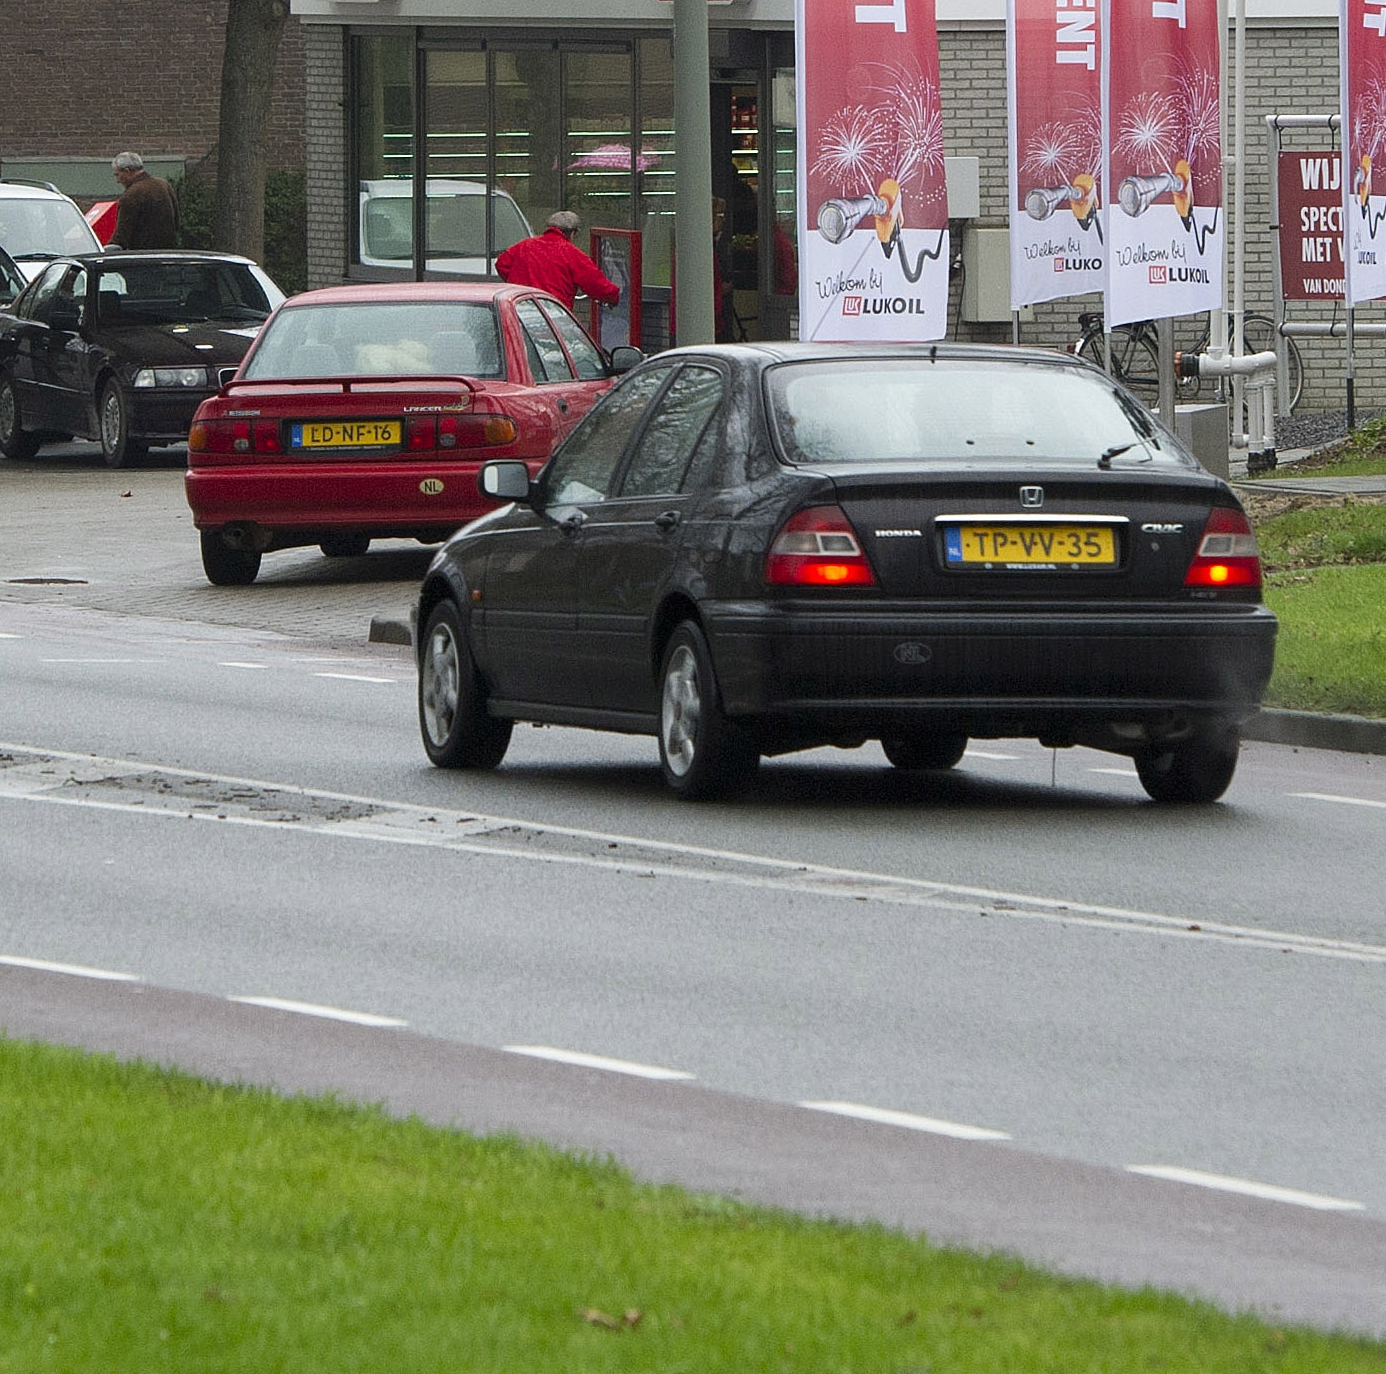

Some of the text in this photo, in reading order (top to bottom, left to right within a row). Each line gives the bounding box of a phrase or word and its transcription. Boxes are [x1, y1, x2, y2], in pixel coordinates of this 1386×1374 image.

[1300, 158, 1342, 190] WIJ
[1024, 237, 1082, 260] Welkom bij
[1117, 239, 1187, 266] Welkom bij
[1302, 238, 1333, 262] MET
[815, 267, 883, 299] Welkom bij
[1169, 267, 1210, 284] LUKOIL
[1303, 279, 1322, 294] VAN
[862, 297, 925, 314] LUKOIL
[311, 424, 392, 443] LD-NF-16
[424, 481, 439, 492] NL
[875, 529, 922, 537] HONDA
[1141, 523, 1183, 534] CIVIC
[973, 531, 1101, 557] TP-VV-35
